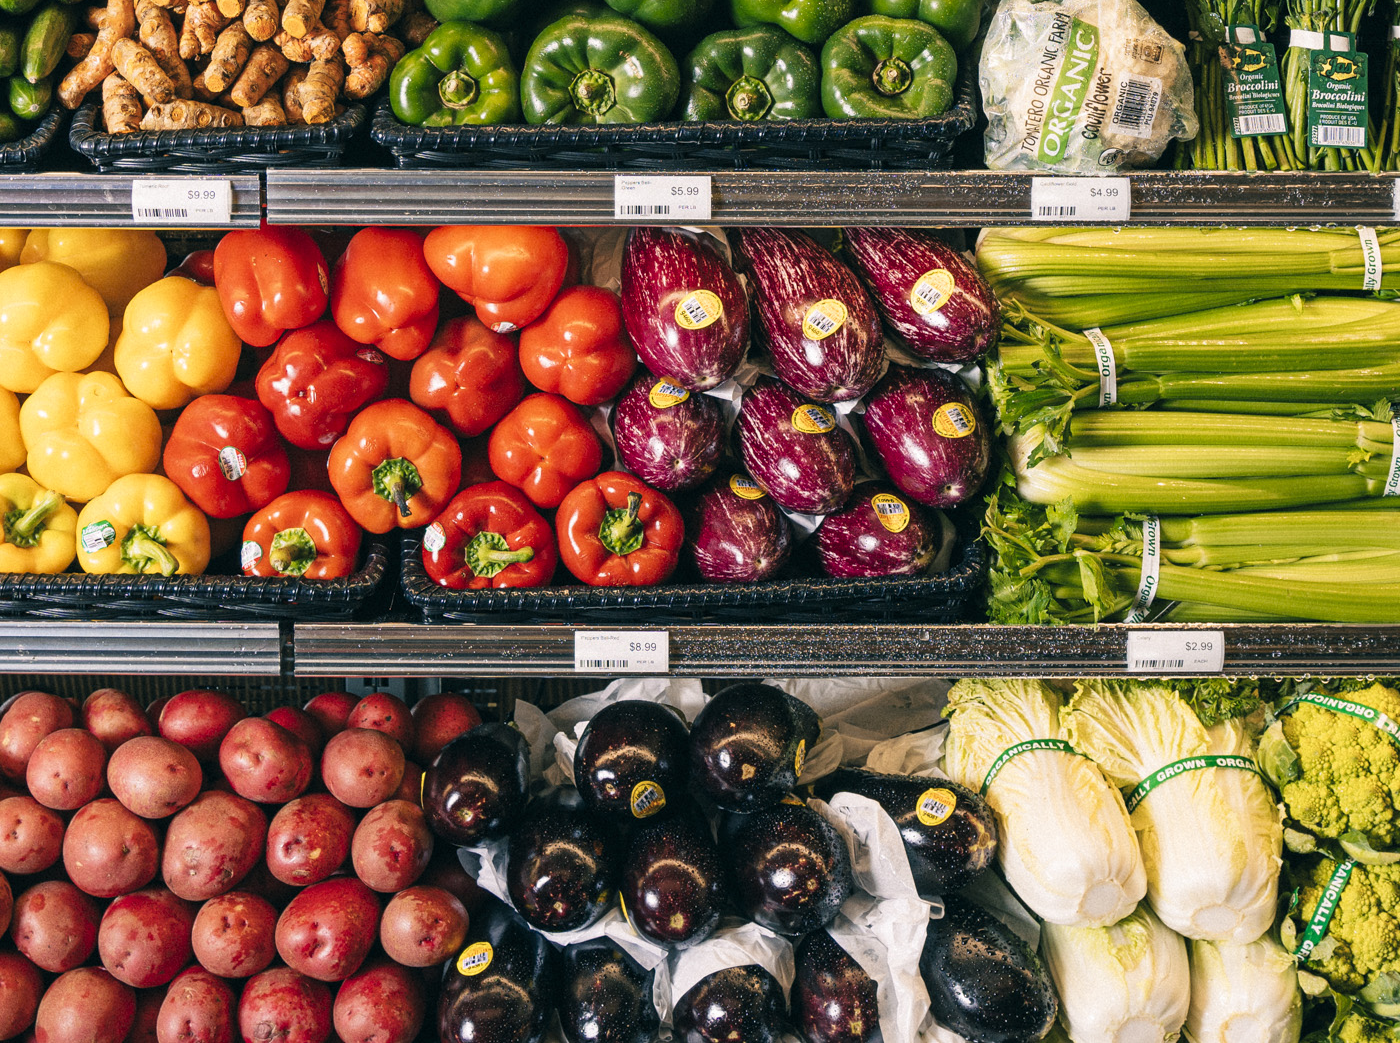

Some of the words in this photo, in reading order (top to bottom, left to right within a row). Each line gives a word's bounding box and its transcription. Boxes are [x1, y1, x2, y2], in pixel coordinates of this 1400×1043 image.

[1022, 99, 1044, 151] TOMATERO
[1034, 47, 1059, 96] ORGANIC
[1049, 12, 1070, 46] FARM
[1240, 74, 1263, 82] Organic
[1228, 81, 1278, 92] Broccolini
[1327, 82, 1351, 91] Organic
[1043, 30, 1095, 156] ORGANIC
[1312, 90, 1365, 102] Broccolini
[1081, 68, 1112, 139] cauliflower
[1112, 81, 1127, 124] ORGANIC
[1144, 112, 1153, 125] PLU
[188, 190, 215, 199] $9.99
[671, 187, 699, 196] $5.99
[1090, 188, 1118, 197] $4.99
[1367, 239, 1377, 275] Grown
[1146, 516, 1158, 557] Grown
[629, 642, 657, 651] $8.99
[1185, 642, 1212, 651] $2.99
[986, 741, 1065, 785] ORGANICALLY
[1156, 759, 1206, 782] GROWN
